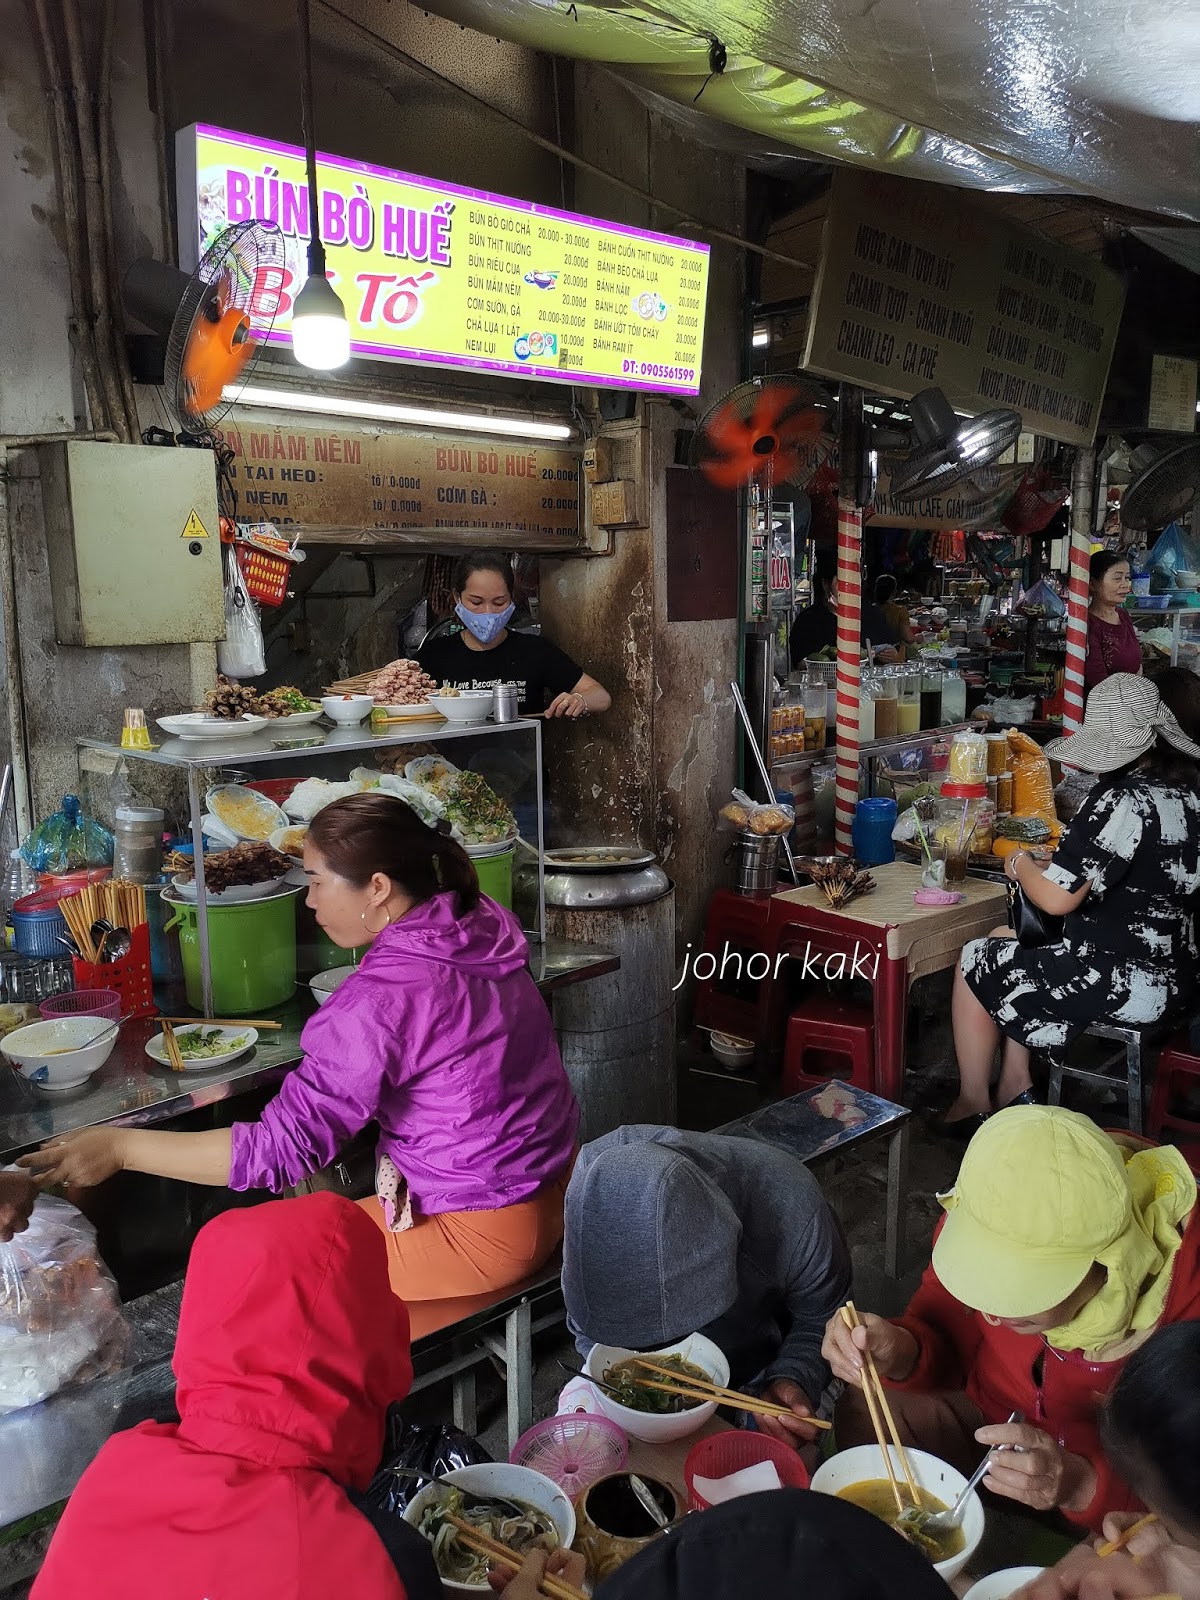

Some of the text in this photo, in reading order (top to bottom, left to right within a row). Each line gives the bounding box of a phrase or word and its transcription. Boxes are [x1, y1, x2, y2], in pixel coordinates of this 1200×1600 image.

[226, 166, 453, 262] BÚN BÒ HUẾ
[469, 210, 485, 225] BÚN
[488, 214, 499, 228] BÒ
[500, 217, 514, 232] GIÒ
[515, 220, 531, 236] CHẢ
[469, 232, 589, 268] BÚN THỊT NƯỚNG 20.000đ
[598, 239, 616, 254] BÁNH
[617, 243, 635, 258] CUỐN
[652, 251, 674, 267] NƯỚNG
[680, 259, 702, 272] 20.000đ
[468, 253, 588, 289] BÚN RIÊU CUA 20.000đ
[597, 259, 701, 291] BÁNH BÈO CHẢ LỤA 20.000đ
[357, 271, 434, 324] Tố
[467, 297, 484, 310] CƠM
[510, 302, 521, 317] GÀ
[468, 274, 484, 290] BÚN
[486, 276, 503, 293] MẮM
[562, 293, 587, 308] 20.000đ
[596, 279, 614, 293] BÁNH
[678, 296, 700, 309] 20.000đ
[845, 271, 884, 314] CHANH
[916, 298, 949, 338] CHANH
[595, 298, 698, 328] BÁNH LỌC 20.000đ
[465, 339, 482, 352] NEM
[484, 341, 496, 355] LỤI
[466, 315, 482, 331] CHẢ
[484, 321, 499, 336] LỤA
[506, 322, 520, 337] LÁT
[560, 334, 585, 347] 10.000đ
[594, 317, 612, 332] BÁNH
[628, 323, 641, 337] TÔM
[642, 326, 659, 340] CHÁY
[675, 333, 697, 346] 20.000đ
[593, 336, 696, 364] BÁNH RAM ÍT 20.000đ
[837, 319, 876, 361] CHANH
[873, 331, 895, 367] LEO
[917, 343, 939, 380] PHÊ
[623, 359, 695, 382] ĐT: 0905561599
[314, 433, 361, 465] NÊM
[436, 444, 578, 482] BÚN BÒ HUẾ 20.000đ
[244, 465, 274, 481] TAI
[281, 467, 324, 483] HEO:
[437, 484, 466, 504] CƠM
[471, 486, 488, 505] GÀ
[541, 497, 578, 510] 20.000đ
[453, 680, 470, 690] Love
[472, 678, 502, 690] Because
